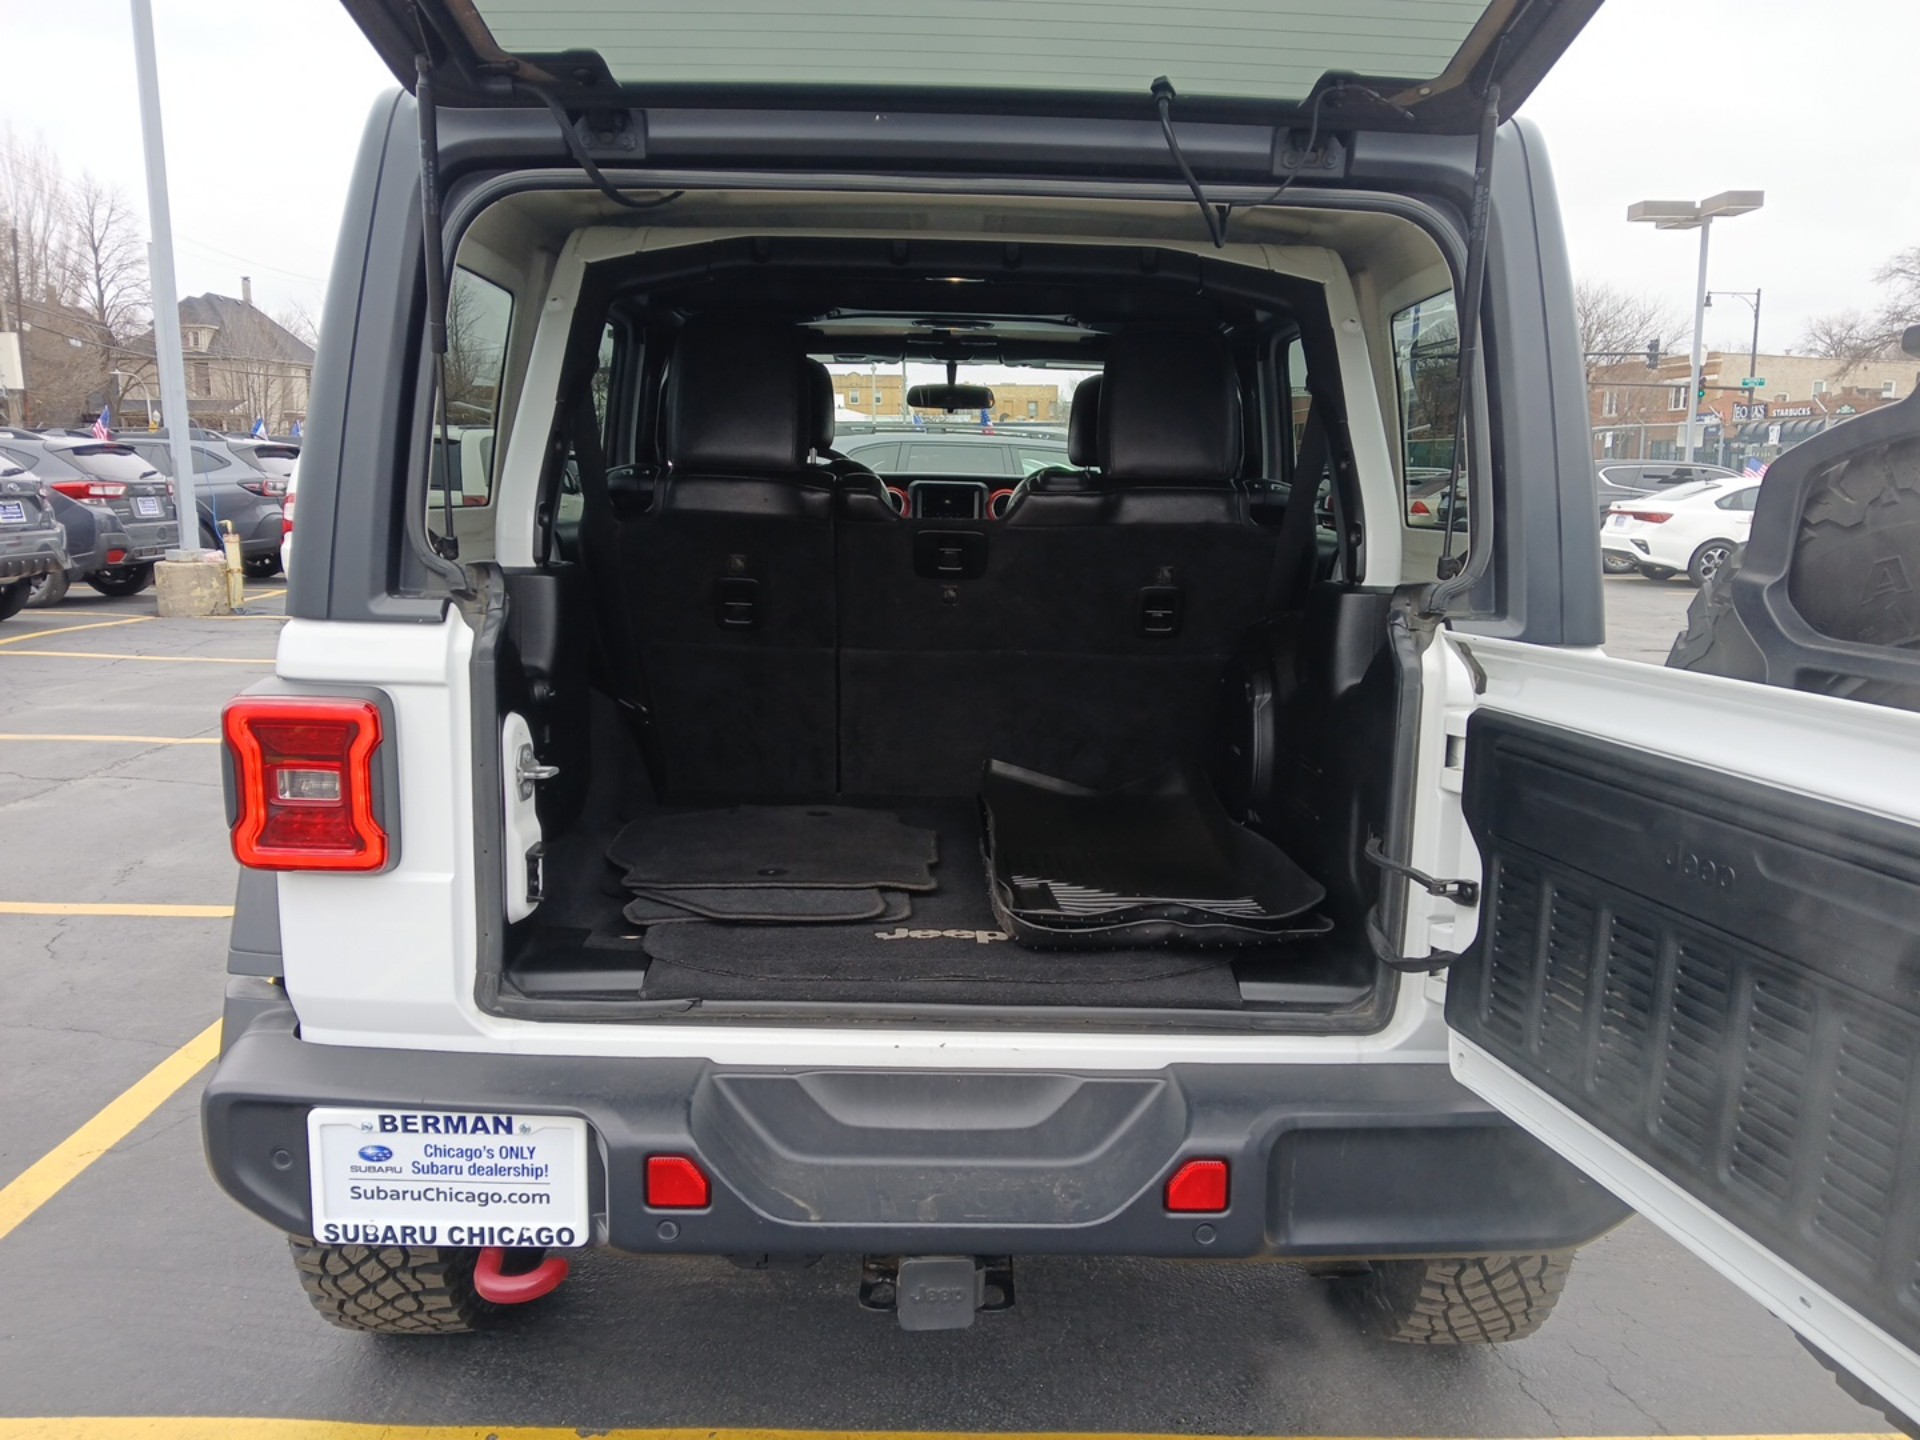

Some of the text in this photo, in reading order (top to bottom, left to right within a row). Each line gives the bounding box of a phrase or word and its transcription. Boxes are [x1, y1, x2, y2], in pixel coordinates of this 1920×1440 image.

[1772, 407, 1811, 417] STARBUCKS
[875, 928, 1009, 944] Jeep
[378, 1114, 513, 1135] BERMAN
[424, 1144, 536, 1161] Chicago's ONLY
[350, 1165, 402, 1174] SUBARU
[411, 1161, 549, 1180] Subaru dealership!
[350, 1186, 550, 1207] SubaruChicago.com
[323, 1223, 575, 1246] SUBARU CHICAGO
[909, 1284, 966, 1305] Jeep
